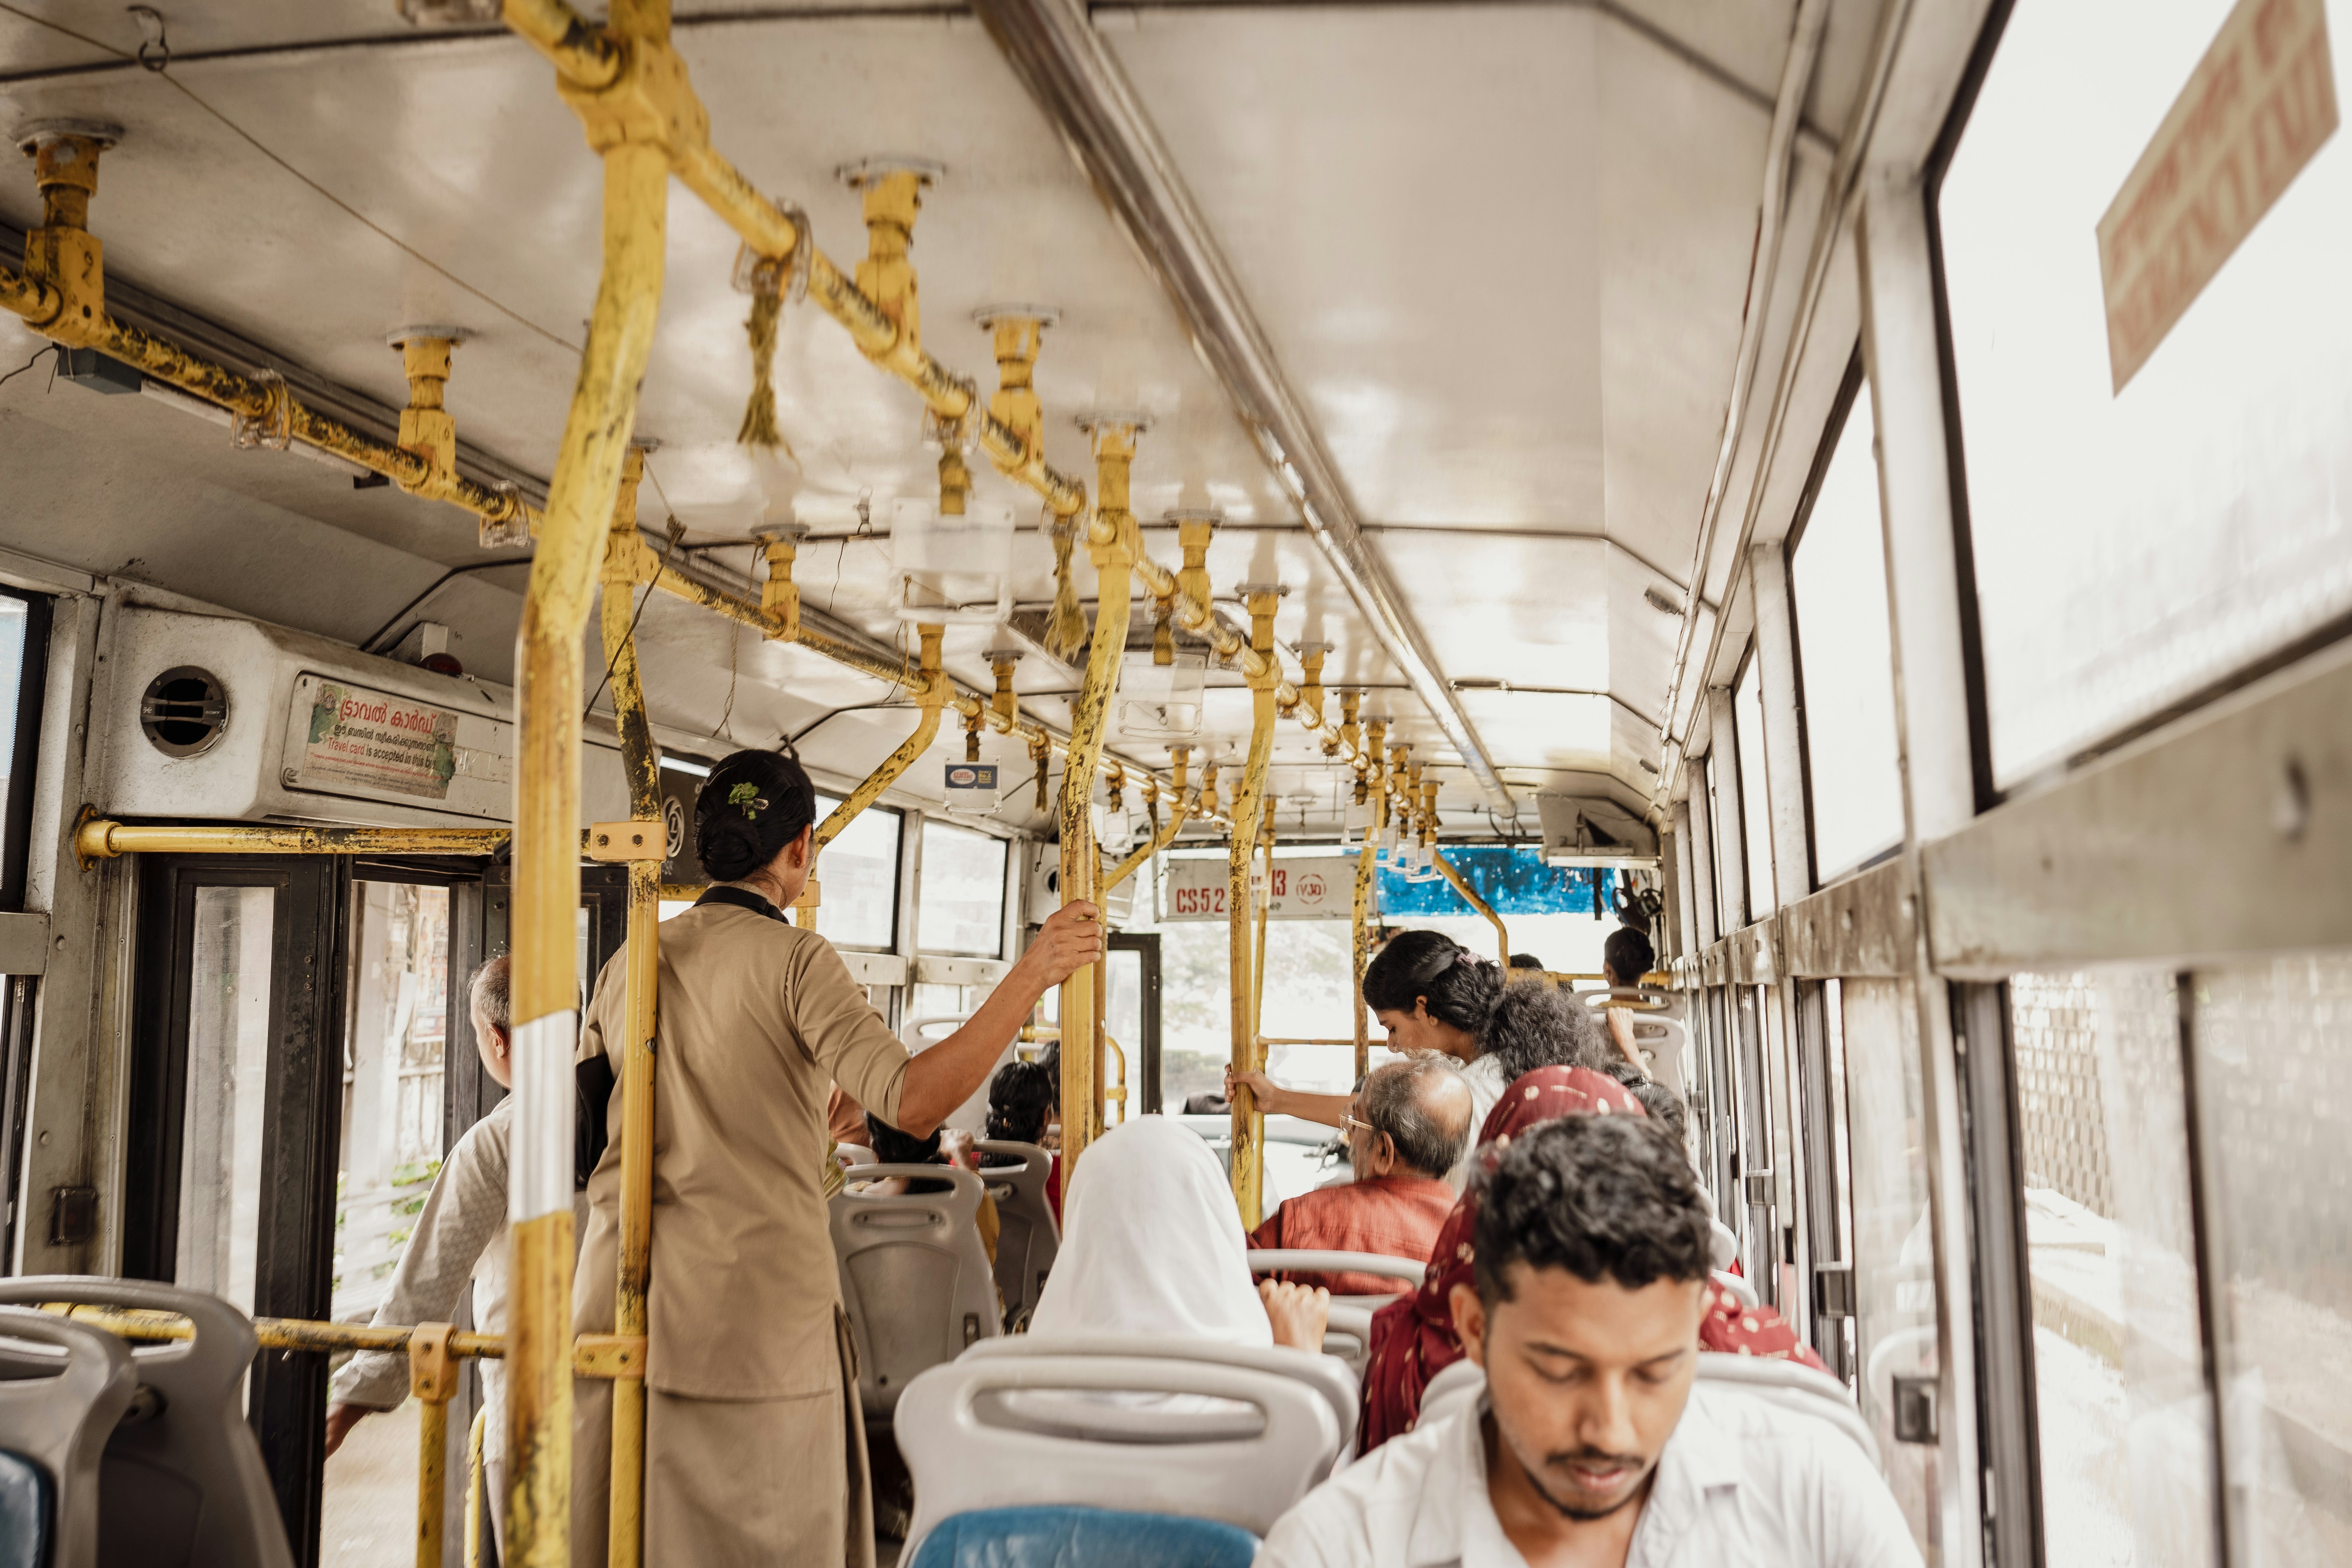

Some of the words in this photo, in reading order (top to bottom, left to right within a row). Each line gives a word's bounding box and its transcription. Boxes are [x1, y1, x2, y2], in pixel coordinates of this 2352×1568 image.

[334, 724, 347, 736] ഈ
[348, 727, 374, 740] ബസിൽ
[340, 699, 388, 724] ട്രാവൽ
[391, 709, 437, 734] കാർഡ്
[328, 737, 349, 752] Travel
[350, 743, 365, 755] card
[366, 744, 372, 757] is
[374, 749, 404, 763] accepted
[405, 752, 411, 764] in
[412, 753, 424, 767] this
[425, 756, 437, 769] bus
